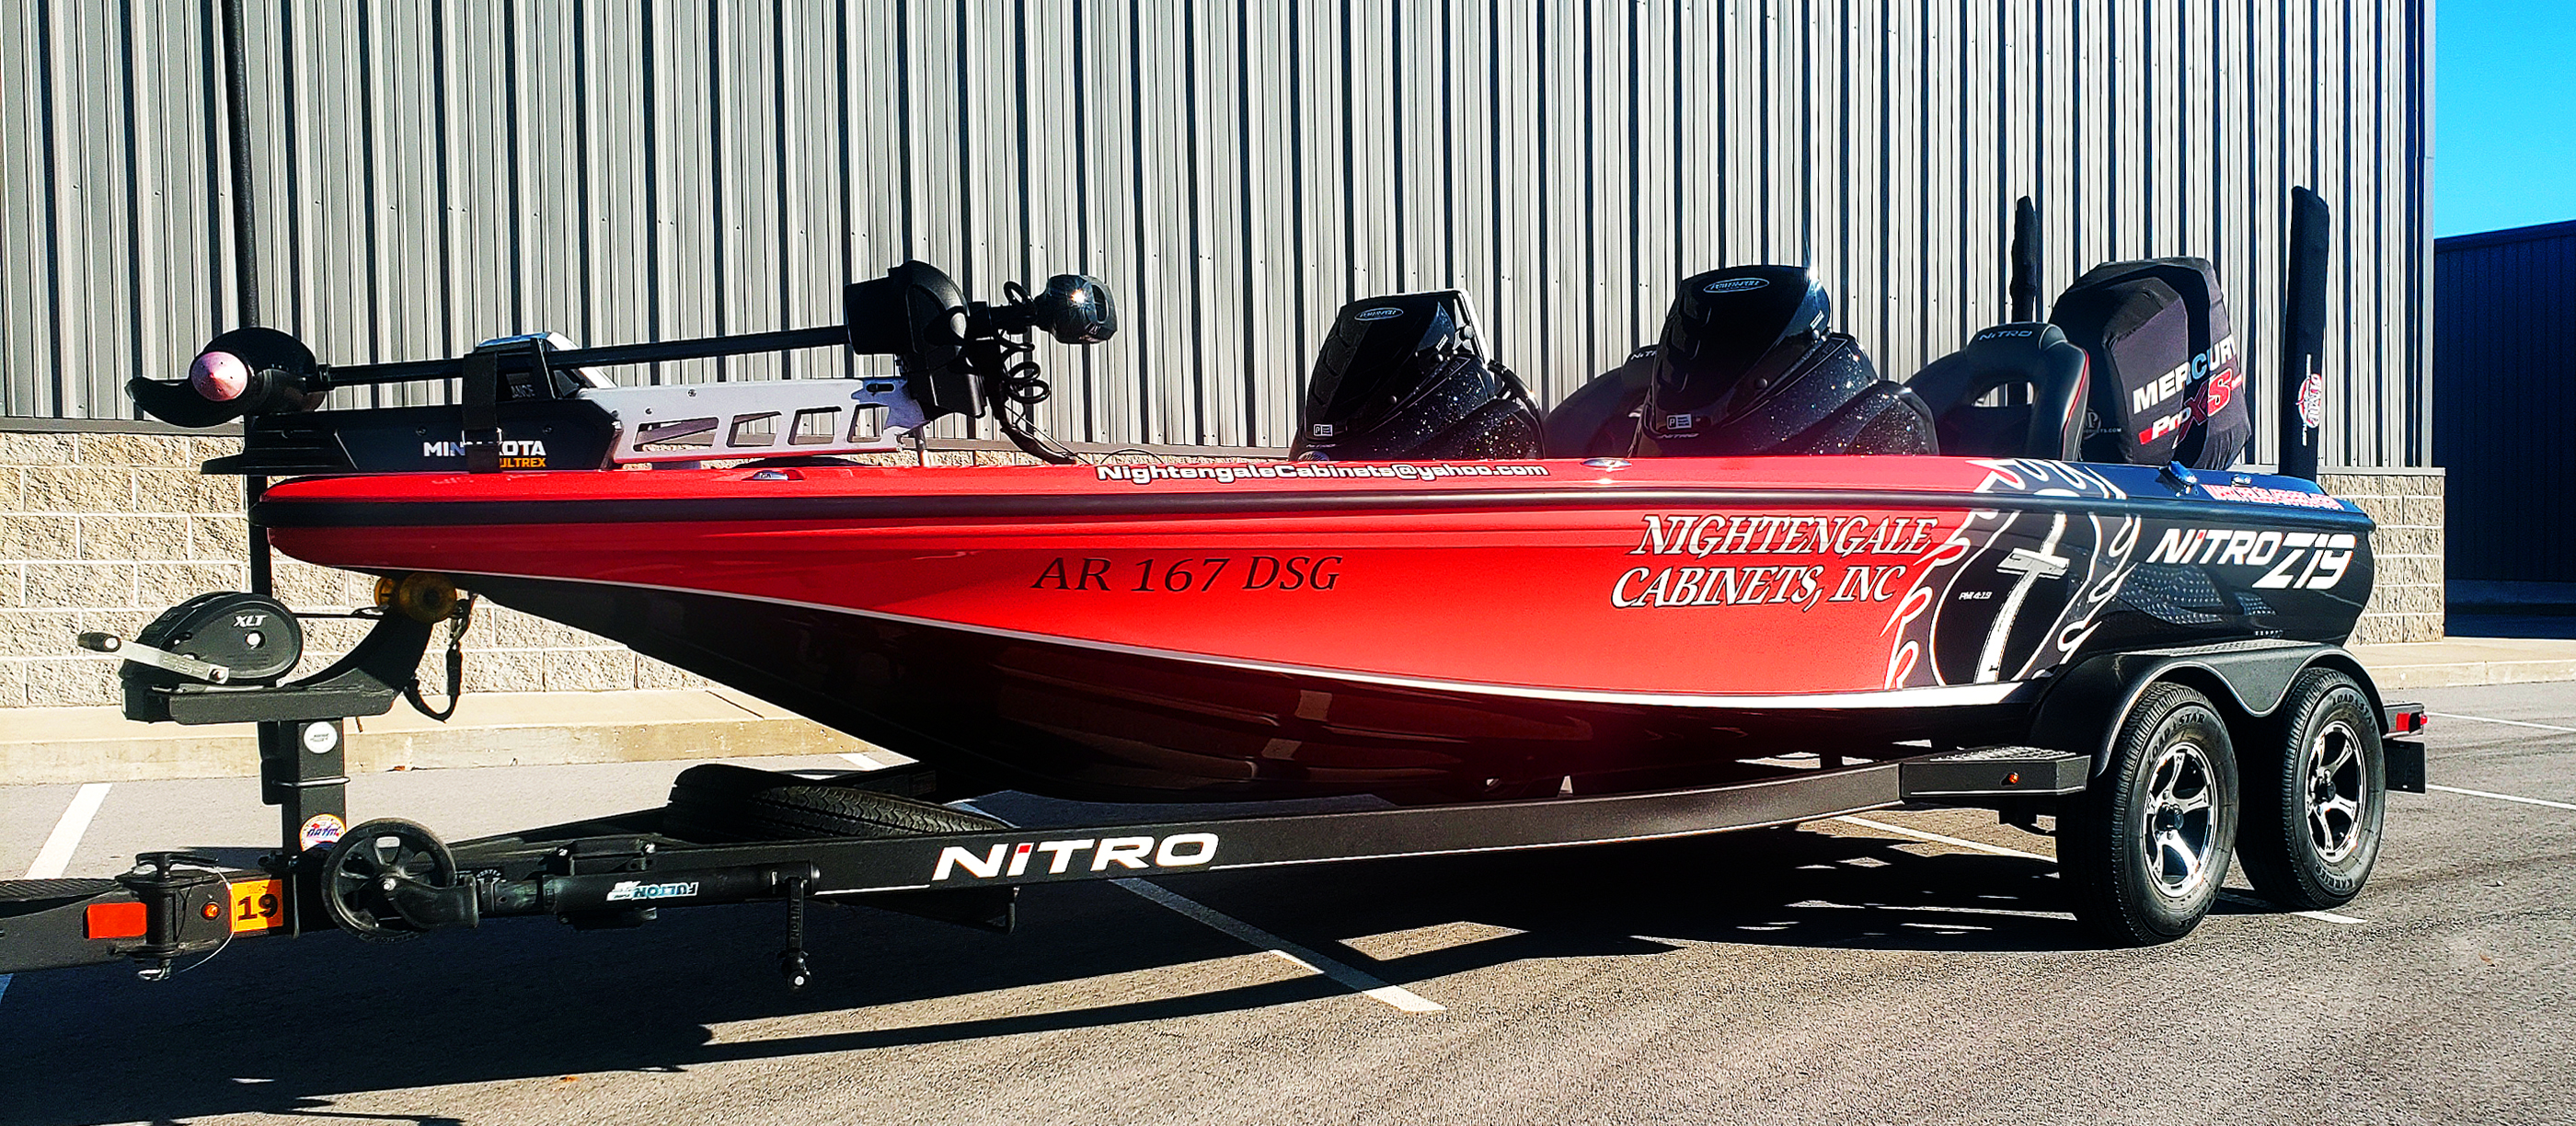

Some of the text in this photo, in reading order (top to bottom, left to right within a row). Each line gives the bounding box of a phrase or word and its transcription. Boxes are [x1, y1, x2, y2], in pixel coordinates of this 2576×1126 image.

[1978, 330, 2033, 341] NITRO
[2132, 334, 2237, 415] MERCUR
[1096, 463, 1549, 485] NightengaleCabinets@yahoo.com
[1627, 514, 1939, 559] NIGHTENGALE
[1030, 556, 1343, 592] AR 167 DSG
[2251, 532, 2358, 590] Z19
[1610, 565, 1908, 612] CABINETS, INC
[233, 615, 268, 627] XLT
[931, 833, 1221, 882] NITRO
[237, 893, 279, 922] 19
[632, 882, 699, 901] FULTON
